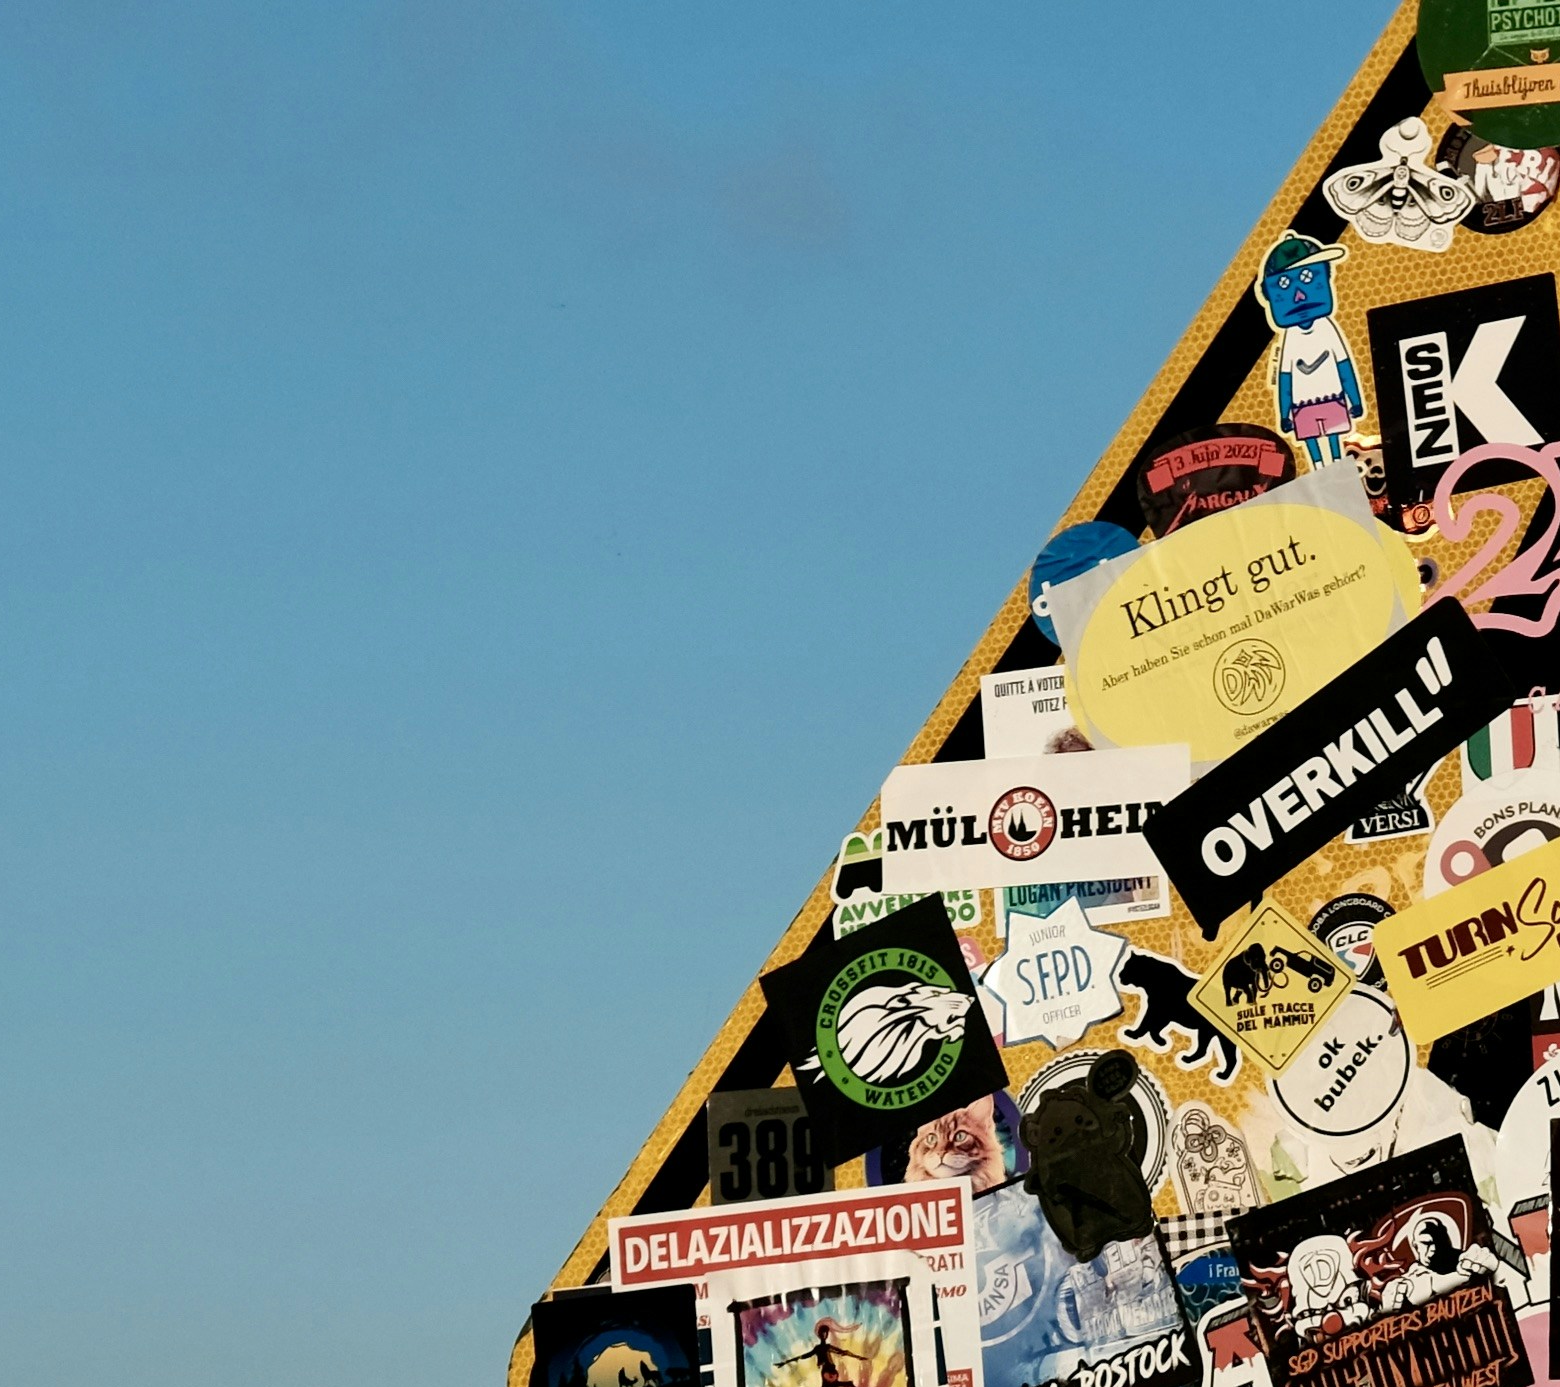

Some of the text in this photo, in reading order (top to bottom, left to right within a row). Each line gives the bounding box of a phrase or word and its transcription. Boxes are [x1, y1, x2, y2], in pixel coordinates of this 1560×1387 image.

[1174, 443, 1259, 470] 3 Juin 2023
[1120, 535, 1317, 640] Klingt gut.
[1101, 565, 1367, 692] Aber haben Sie schon mal DaWarWas gehört?
[886, 806, 988, 854] MÜL
[1011, 791, 1054, 830] KOELN
[1473, 805, 1517, 839] BONS
[1005, 842, 1040, 858] 1850
[1029, 925, 1066, 946] JUNIOR
[1397, 901, 1519, 980] TURN
[820, 952, 939, 1029] CROSSFIT 1815
[1236, 1002, 1315, 1020] SULLE TRACCE
[1042, 1005, 1082, 1025] OFFICER
[1236, 1014, 1316, 1032] DEL MAMMUT
[1313, 1033, 1384, 1112] bubek.
[1318, 1035, 1345, 1070] ok
[864, 1053, 954, 1106] WATERLOO
[624, 1199, 958, 1274] DELAZIALIZZAZIONE
[1324, 1284, 1493, 1363] SUPPORTERS BAUTZEN
